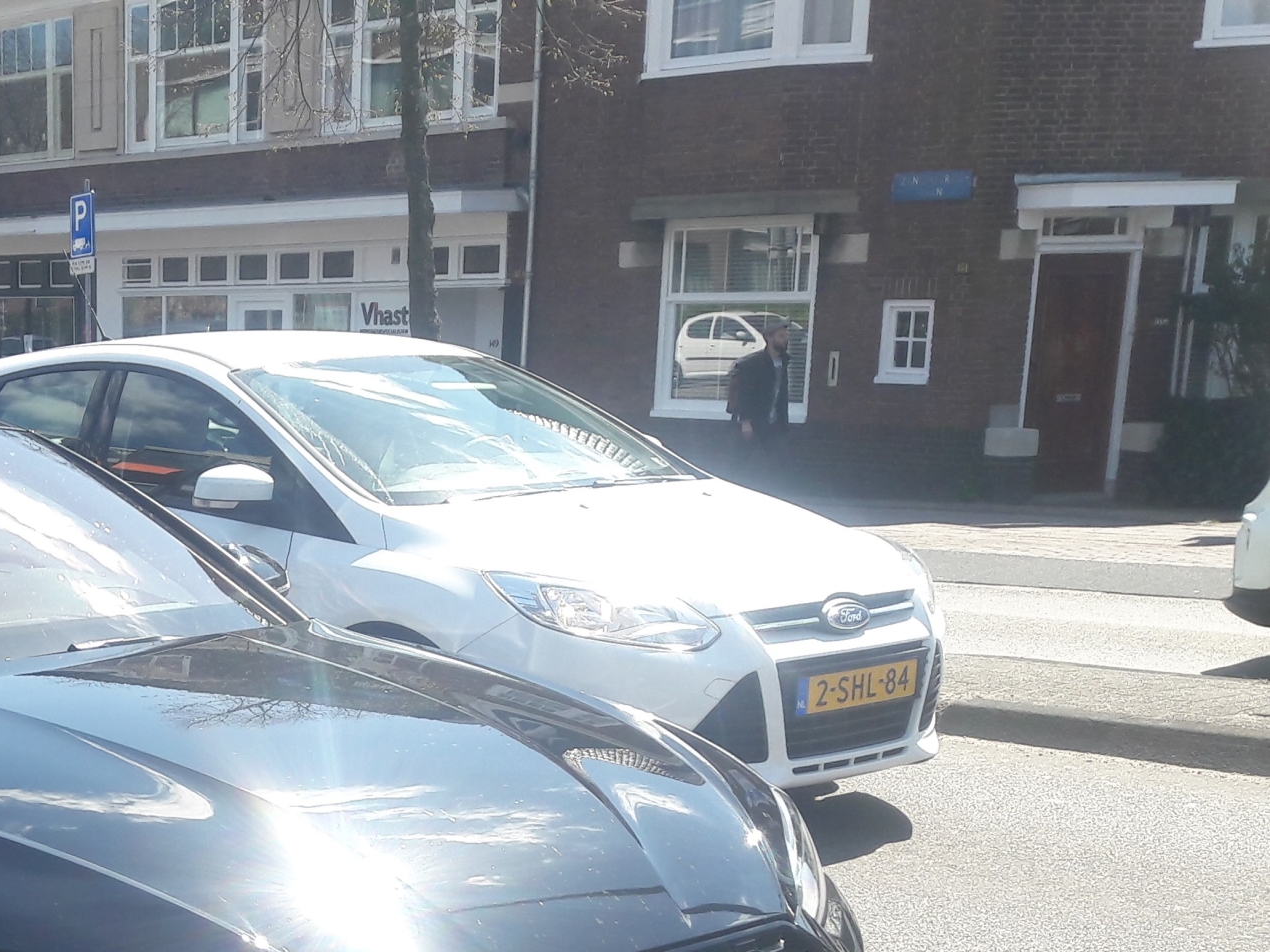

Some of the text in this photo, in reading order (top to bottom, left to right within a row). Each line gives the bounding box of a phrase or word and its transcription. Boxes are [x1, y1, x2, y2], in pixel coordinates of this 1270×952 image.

[75, 200, 87, 231] P
[361, 302, 409, 326] Vhast
[840, 608, 863, 622] Ford
[816, 665, 909, 706] 2-SHL-84
[797, 700, 806, 709] NL
